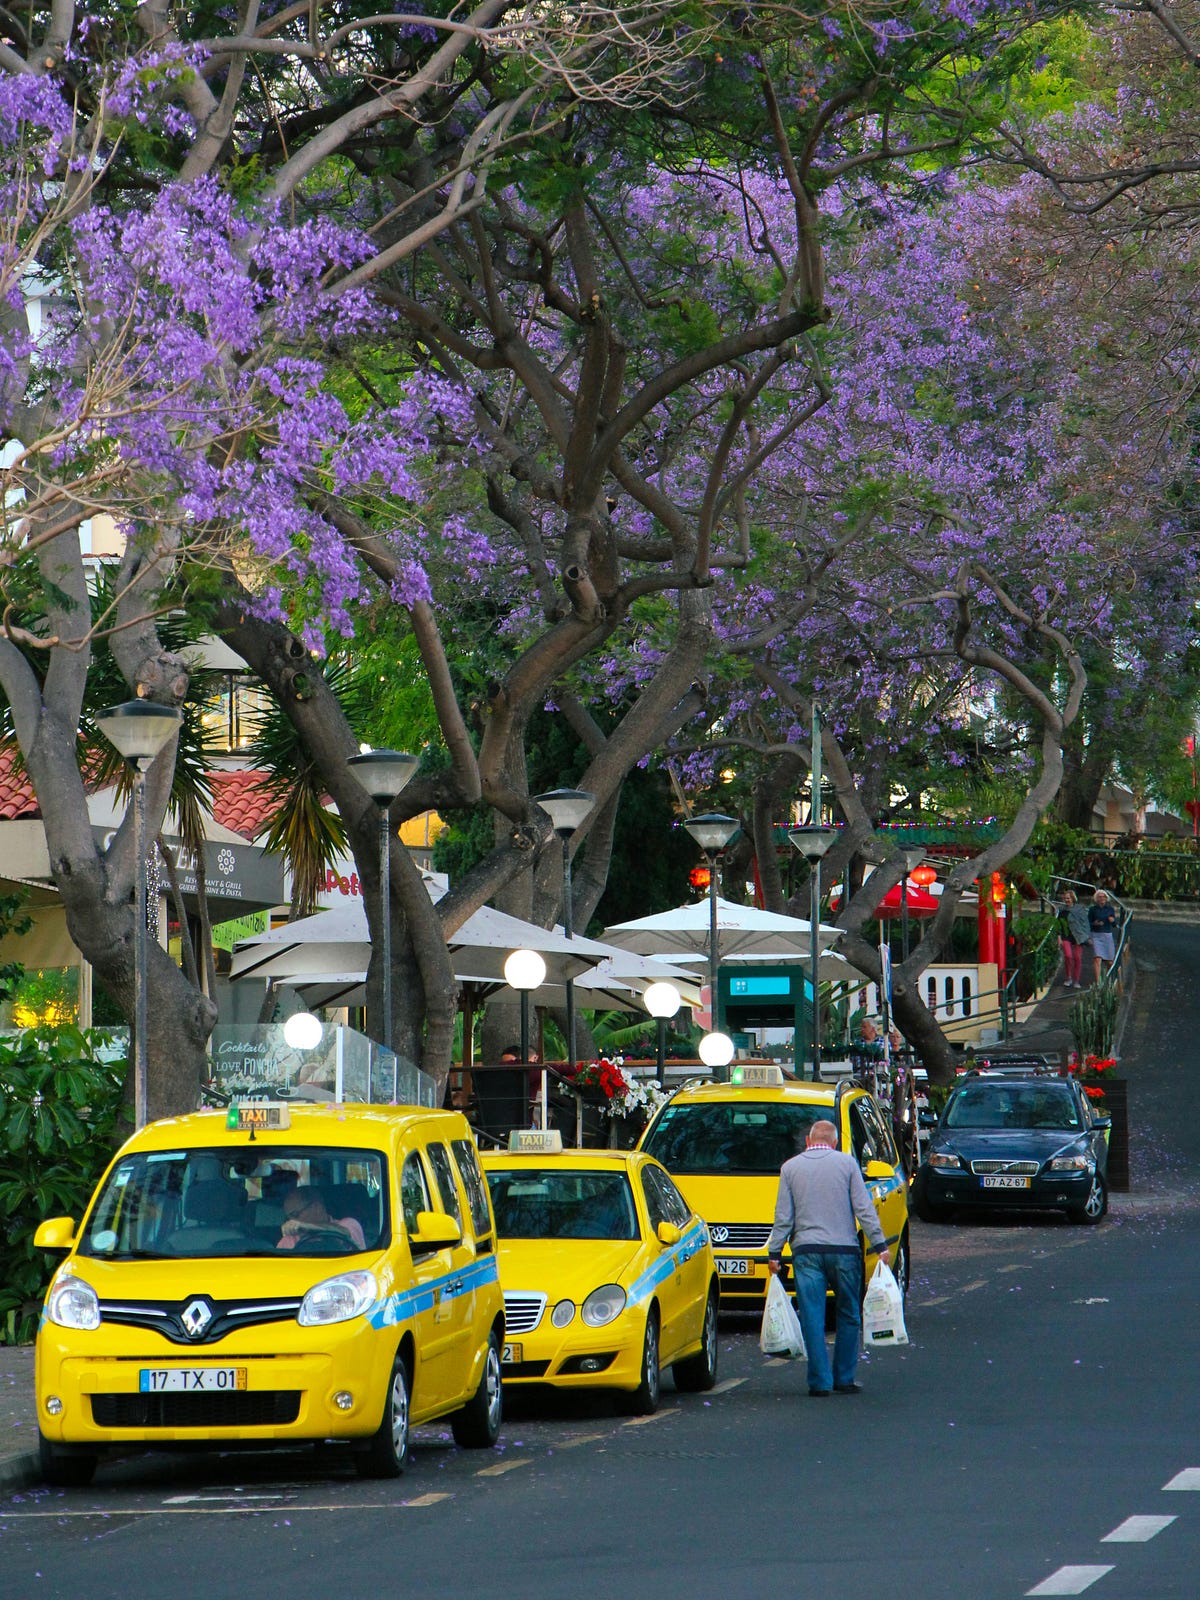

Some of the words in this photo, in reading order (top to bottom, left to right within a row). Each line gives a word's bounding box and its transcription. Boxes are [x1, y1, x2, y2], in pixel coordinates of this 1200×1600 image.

[225, 881, 241, 890] GRILL
[226, 888, 242, 897] PASTA
[218, 1041, 268, 1054] Cocktails
[216, 1061, 241, 1072] LOVE
[744, 1068, 767, 1080] TAXI
[240, 1109, 267, 1122] TAXI
[520, 1134, 543, 1146] TAXI
